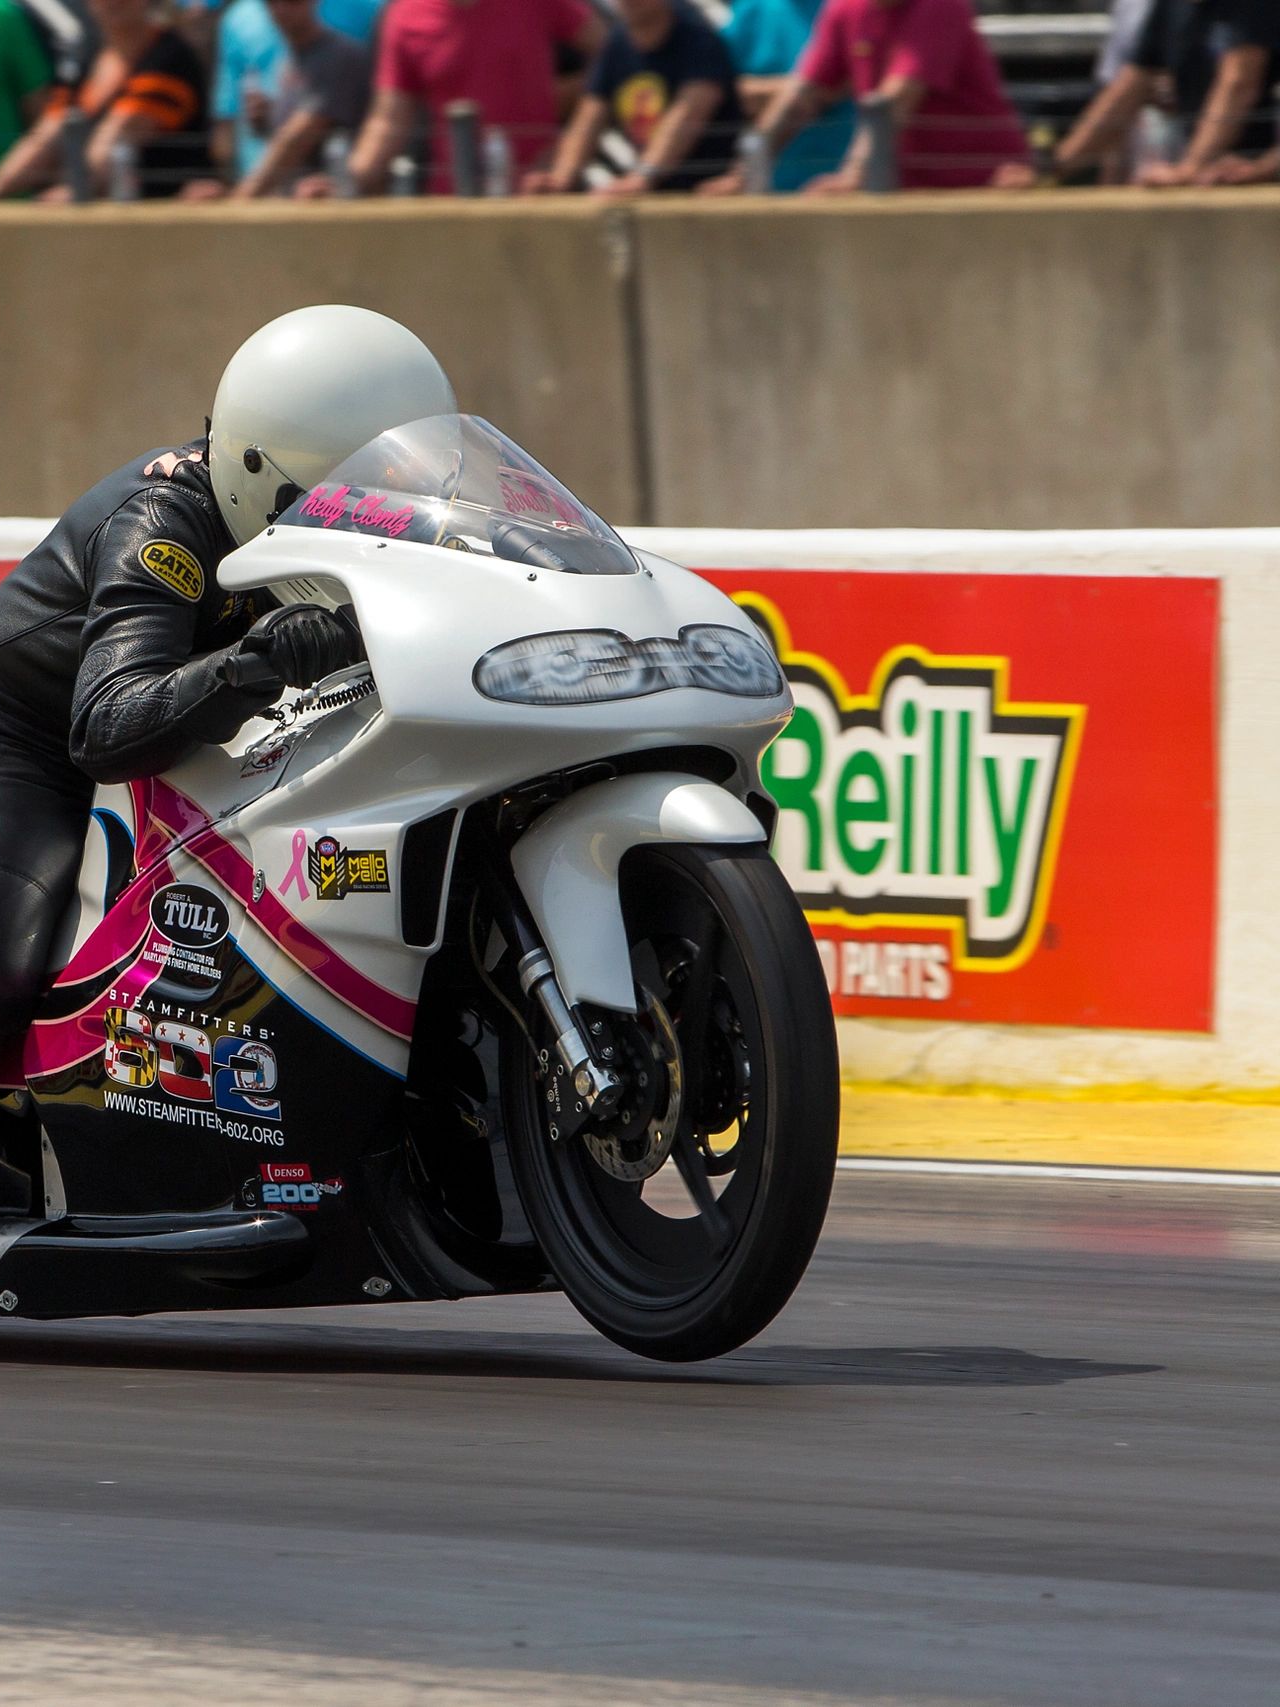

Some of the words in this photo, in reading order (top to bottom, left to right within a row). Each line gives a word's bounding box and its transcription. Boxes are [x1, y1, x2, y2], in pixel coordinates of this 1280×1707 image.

[146, 547, 200, 593] BATES
[168, 547, 196, 570] CUSTOM
[153, 565, 188, 592] LEATHERS
[166, 892, 186, 901] ROBERT
[164, 899, 219, 933] TULL
[171, 957, 187, 970] FINEST
[176, 948, 205, 964] CONTRACTOR
[205, 955, 215, 967] FOR
[840, 941, 953, 1000] PARTS
[109, 989, 269, 1040] STEAMFITTERS
[103, 1006, 282, 1121] 602
[274, 1168, 304, 1177] DENSO
[262, 1183, 321, 1203] 200
